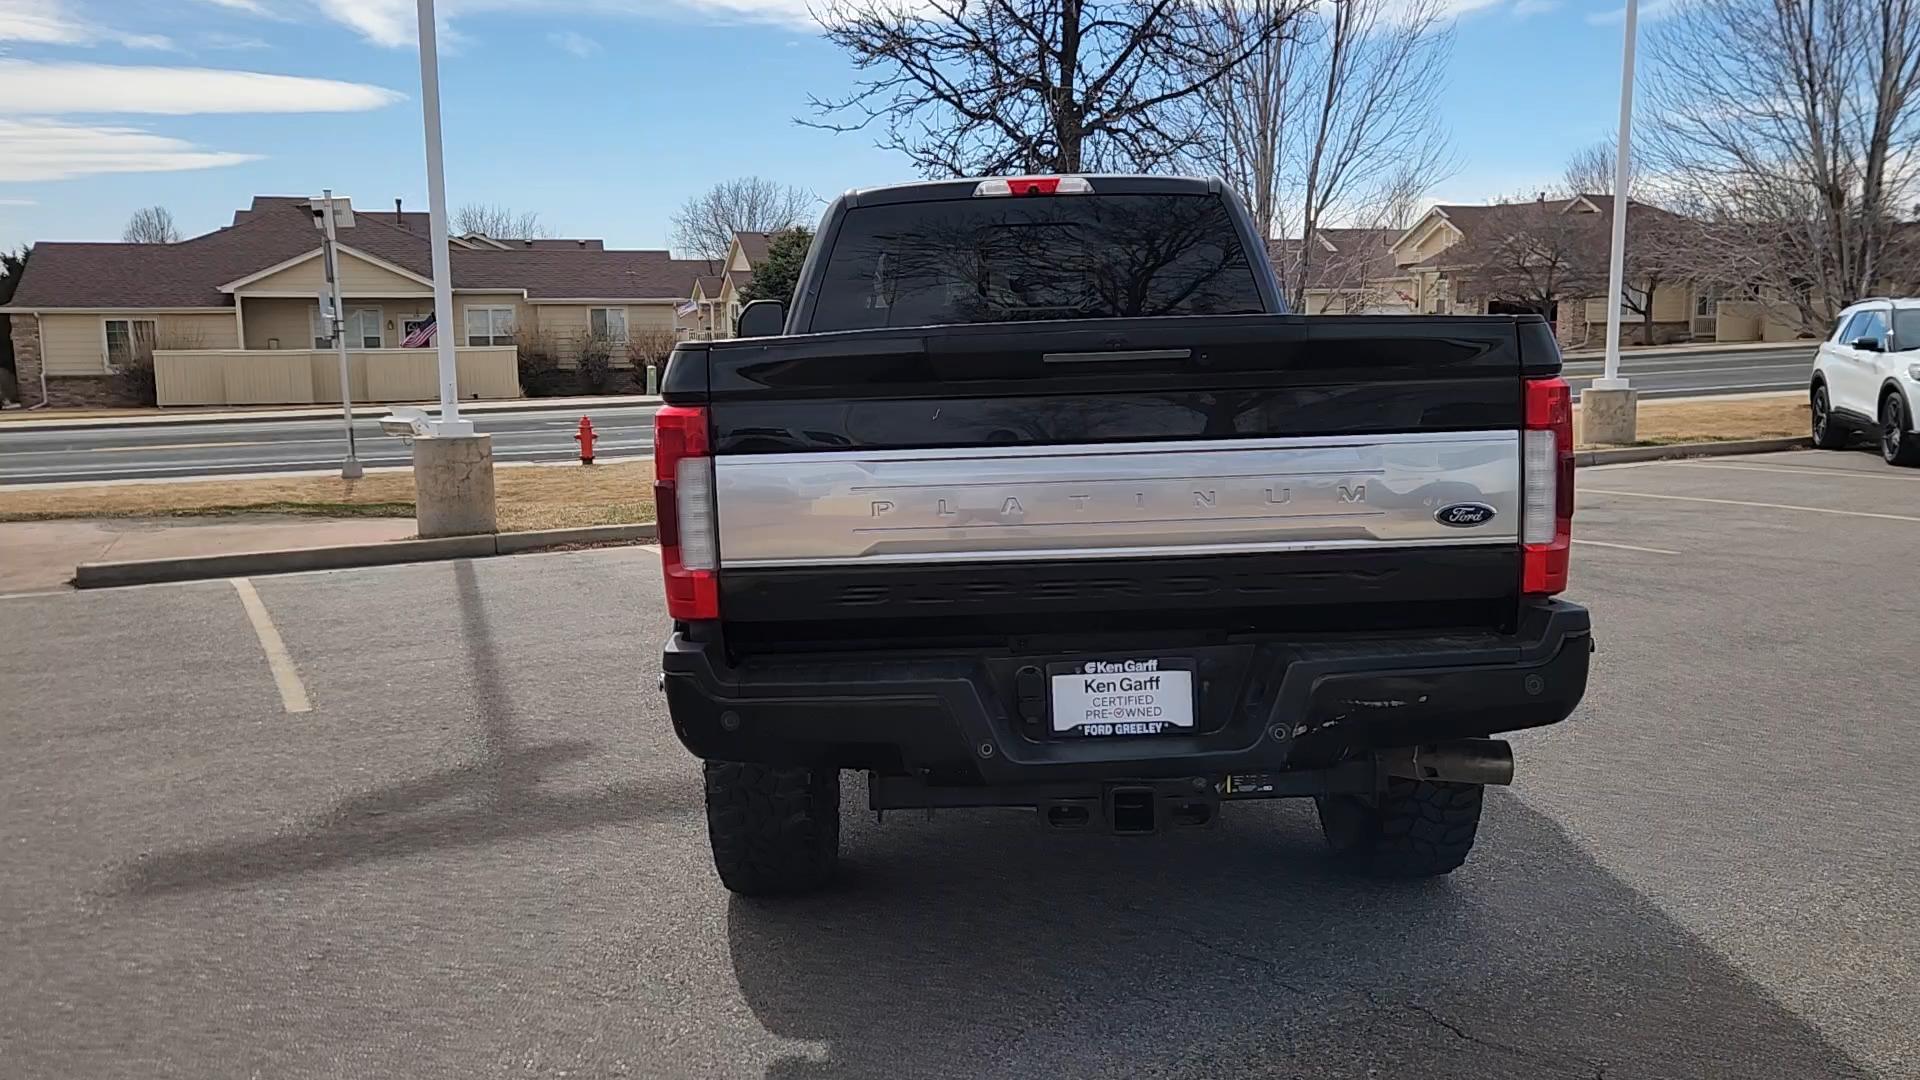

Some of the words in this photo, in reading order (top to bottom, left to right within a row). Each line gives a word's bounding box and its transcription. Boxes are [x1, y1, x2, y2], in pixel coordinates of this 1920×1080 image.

[871, 485, 1367, 518] PLATINUM
[1449, 507, 1484, 522] Ford
[1097, 661, 1124, 673] Ken
[1124, 659, 1158, 672] Garff
[1084, 679, 1116, 693] Ken
[1120, 676, 1160, 692] Garff
[1092, 695, 1154, 707] CERTIFIED
[1084, 724, 1113, 736] FORD
[1115, 722, 1163, 735] GREELEY
